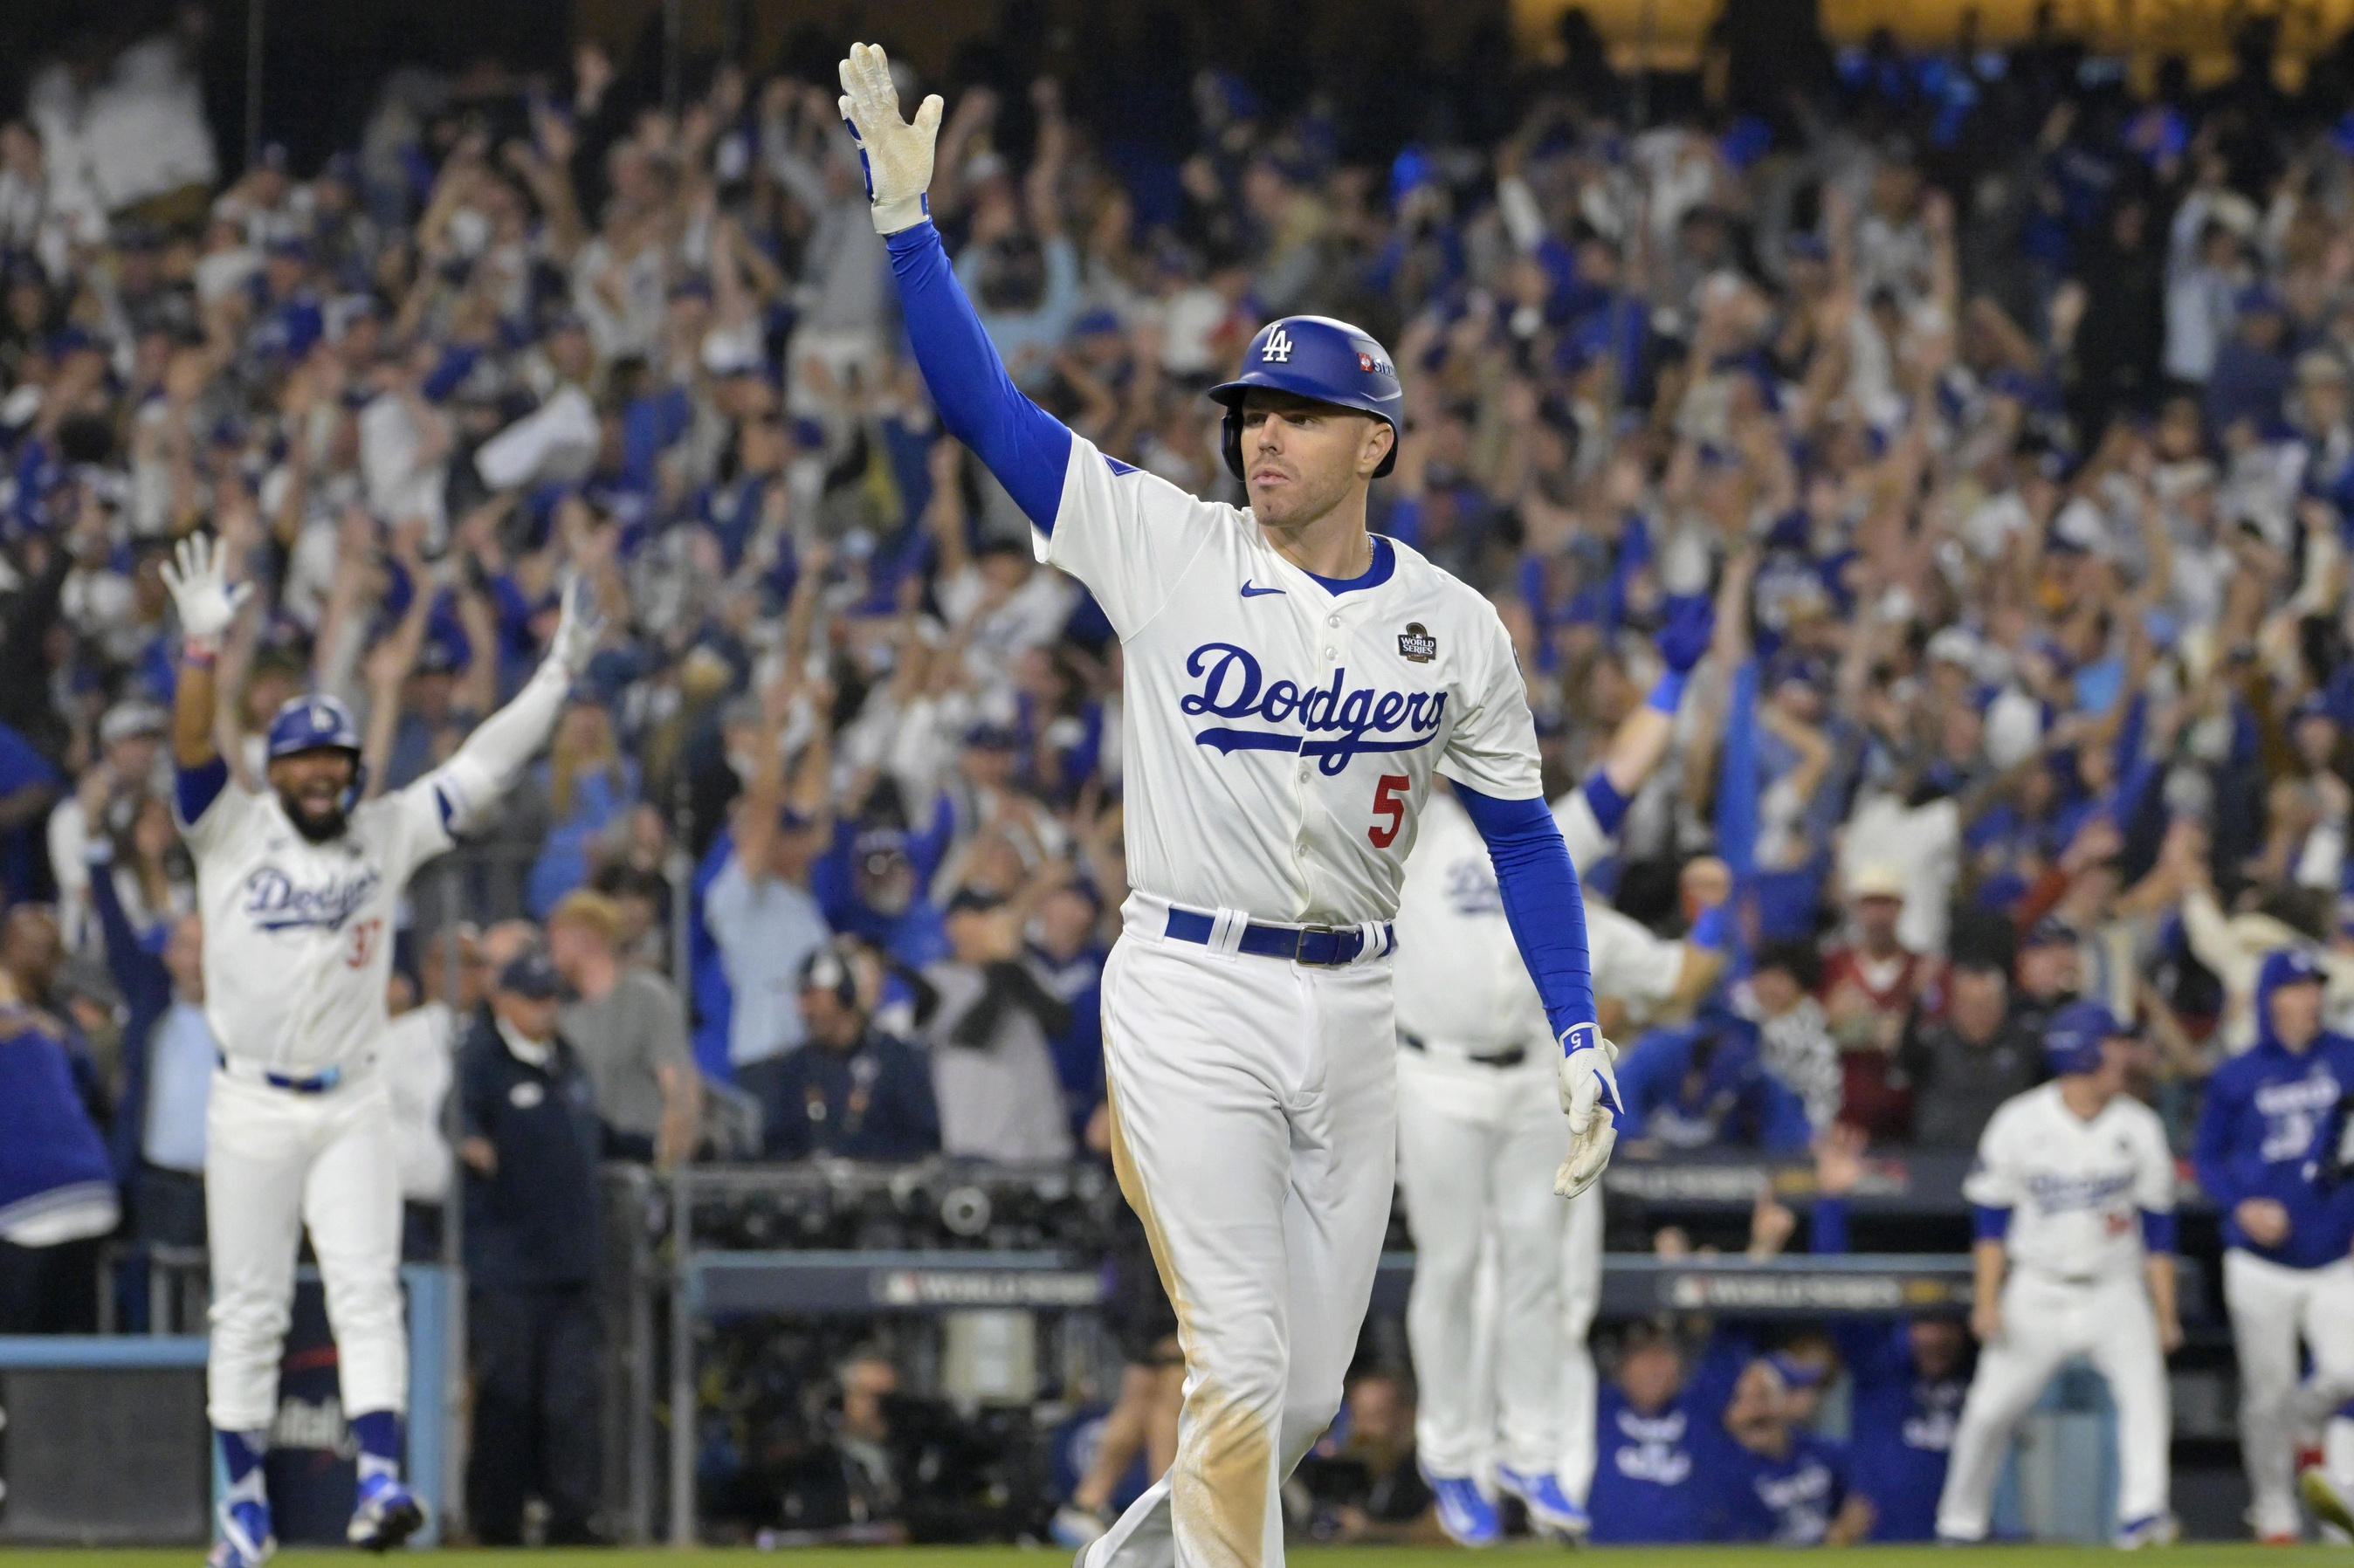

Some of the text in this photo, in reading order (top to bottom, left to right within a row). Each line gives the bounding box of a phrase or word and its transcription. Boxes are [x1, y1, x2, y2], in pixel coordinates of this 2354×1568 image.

[1262, 324, 1293, 362] LA
[1401, 636, 1435, 648] WORLD
[1402, 644, 1434, 655] SERIES
[1180, 642, 1448, 776] Dodgers
[1367, 774, 1411, 849] 5
